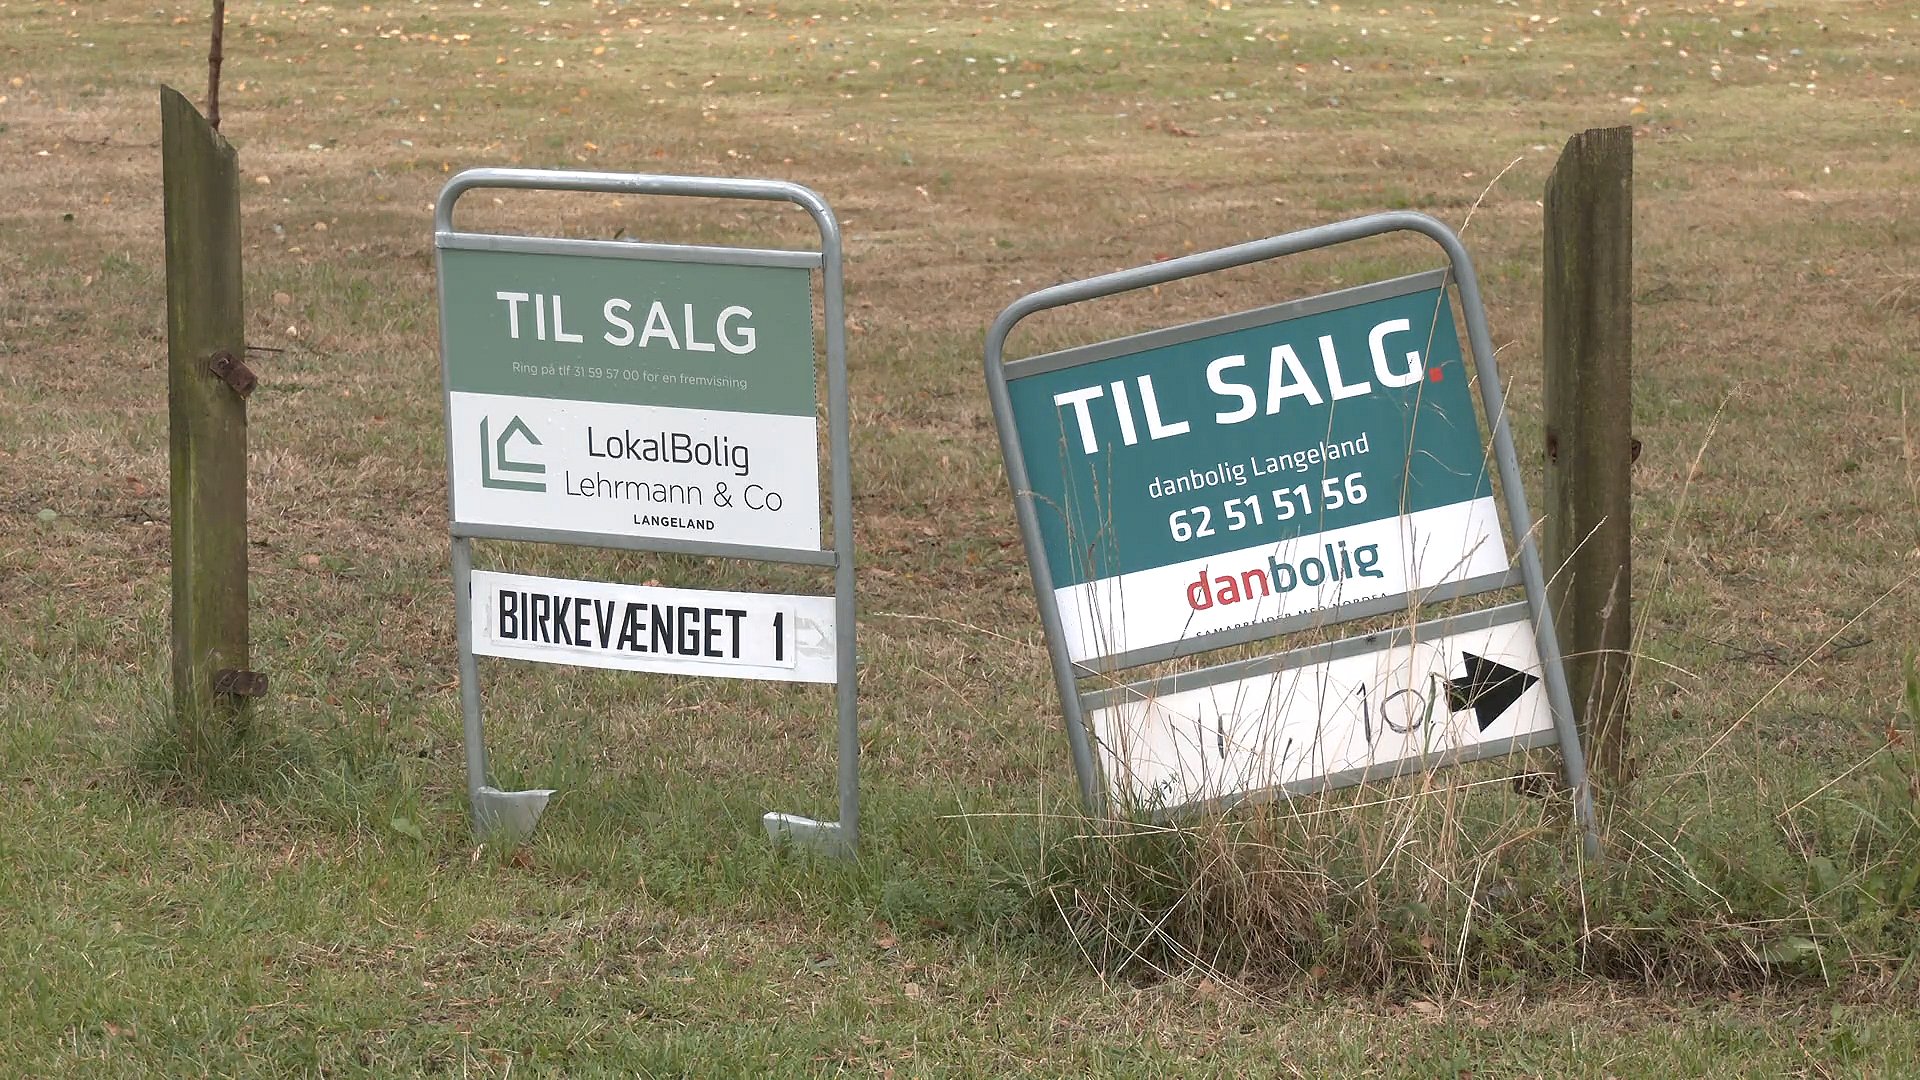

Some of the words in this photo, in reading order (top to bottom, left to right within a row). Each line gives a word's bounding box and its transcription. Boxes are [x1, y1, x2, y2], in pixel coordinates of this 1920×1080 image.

[496, 290, 584, 344] TIL
[603, 298, 757, 355] SALG
[512, 361, 538, 376] Ring
[541, 363, 555, 376] på
[558, 364, 571, 377] tlf
[574, 366, 585, 377] 31
[588, 366, 603, 379] 59
[606, 368, 619, 380] 57
[622, 369, 640, 381] 00
[643, 370, 660, 382] for
[662, 374, 677, 384] en
[680, 372, 748, 391] fremvisning
[1053, 374, 1191, 456] TIL
[588, 426, 749, 476] LokalBolig
[1148, 461, 1248, 499] danbolig
[1250, 431, 1370, 477] Langeland
[565, 470, 702, 506] Lehrmann
[713, 481, 733, 508] &
[744, 484, 783, 512] Co
[633, 514, 715, 531] LANGELAND
[1168, 504, 1216, 543] 62
[1223, 494, 1264, 531] 51
[1272, 483, 1313, 521] 51
[1321, 471, 1368, 510] 56
[1187, 540, 1384, 611] danbolig
[499, 589, 747, 659] BIRKEVÆNGET
[772, 611, 784, 661] 1
